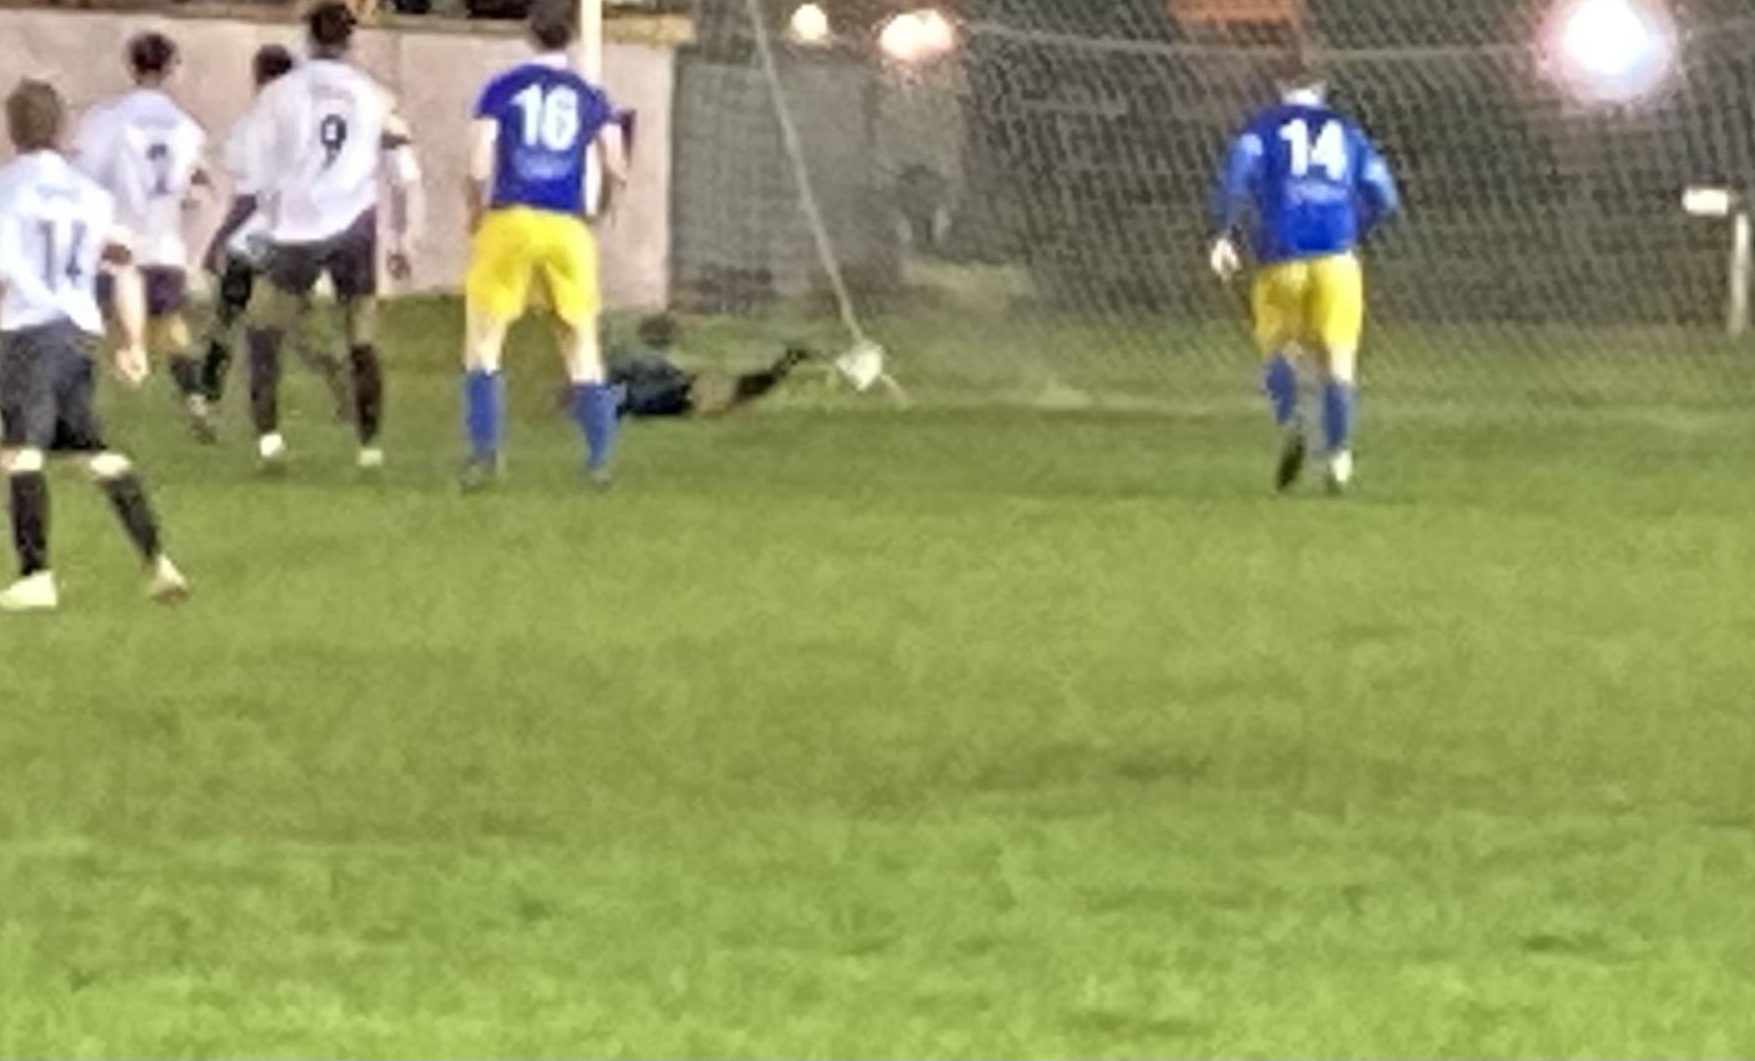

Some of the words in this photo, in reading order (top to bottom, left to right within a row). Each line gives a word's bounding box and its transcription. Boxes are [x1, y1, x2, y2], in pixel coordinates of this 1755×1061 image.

[318, 113, 347, 171] 9
[509, 84, 579, 151] 16
[1278, 118, 1345, 181] 14
